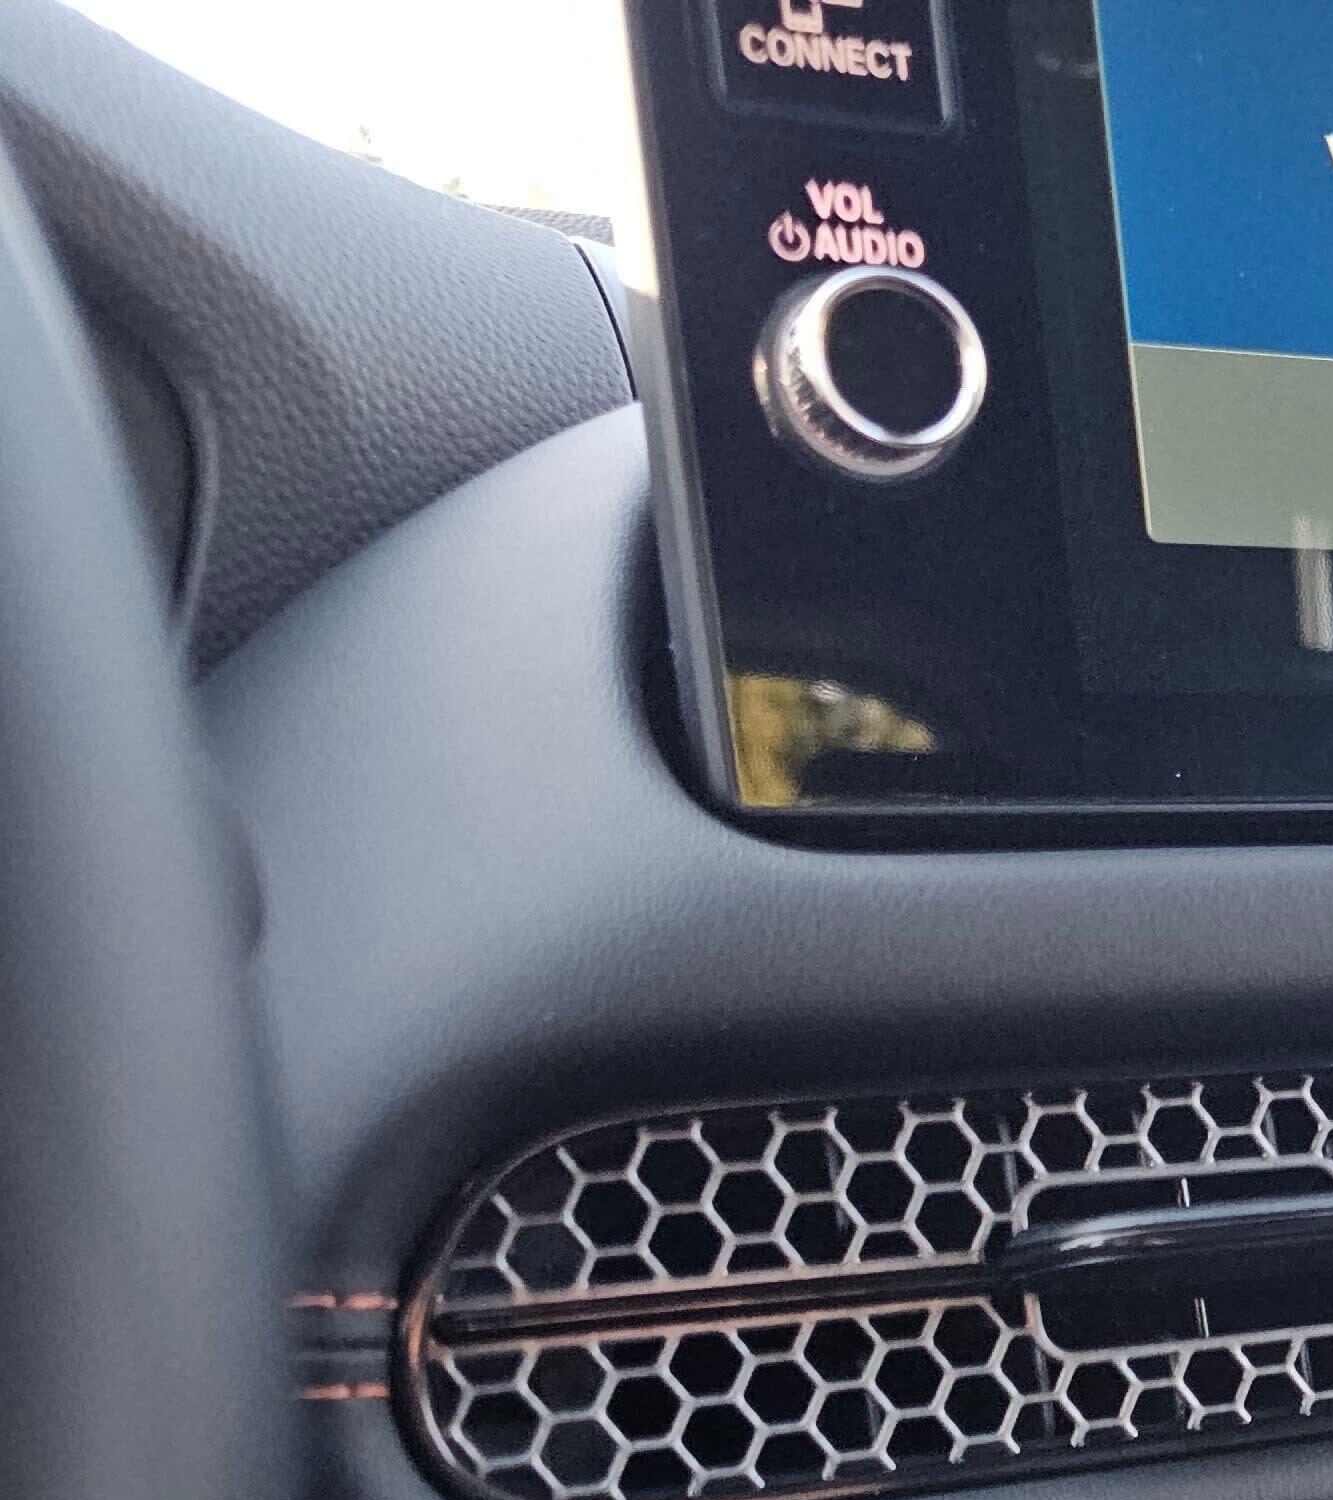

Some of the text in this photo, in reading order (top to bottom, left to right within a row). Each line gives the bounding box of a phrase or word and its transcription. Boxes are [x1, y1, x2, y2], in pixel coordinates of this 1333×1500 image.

[738, 22, 913, 82] CONNECT
[804, 176, 885, 226] VOL
[813, 221, 926, 269] AUDIO
